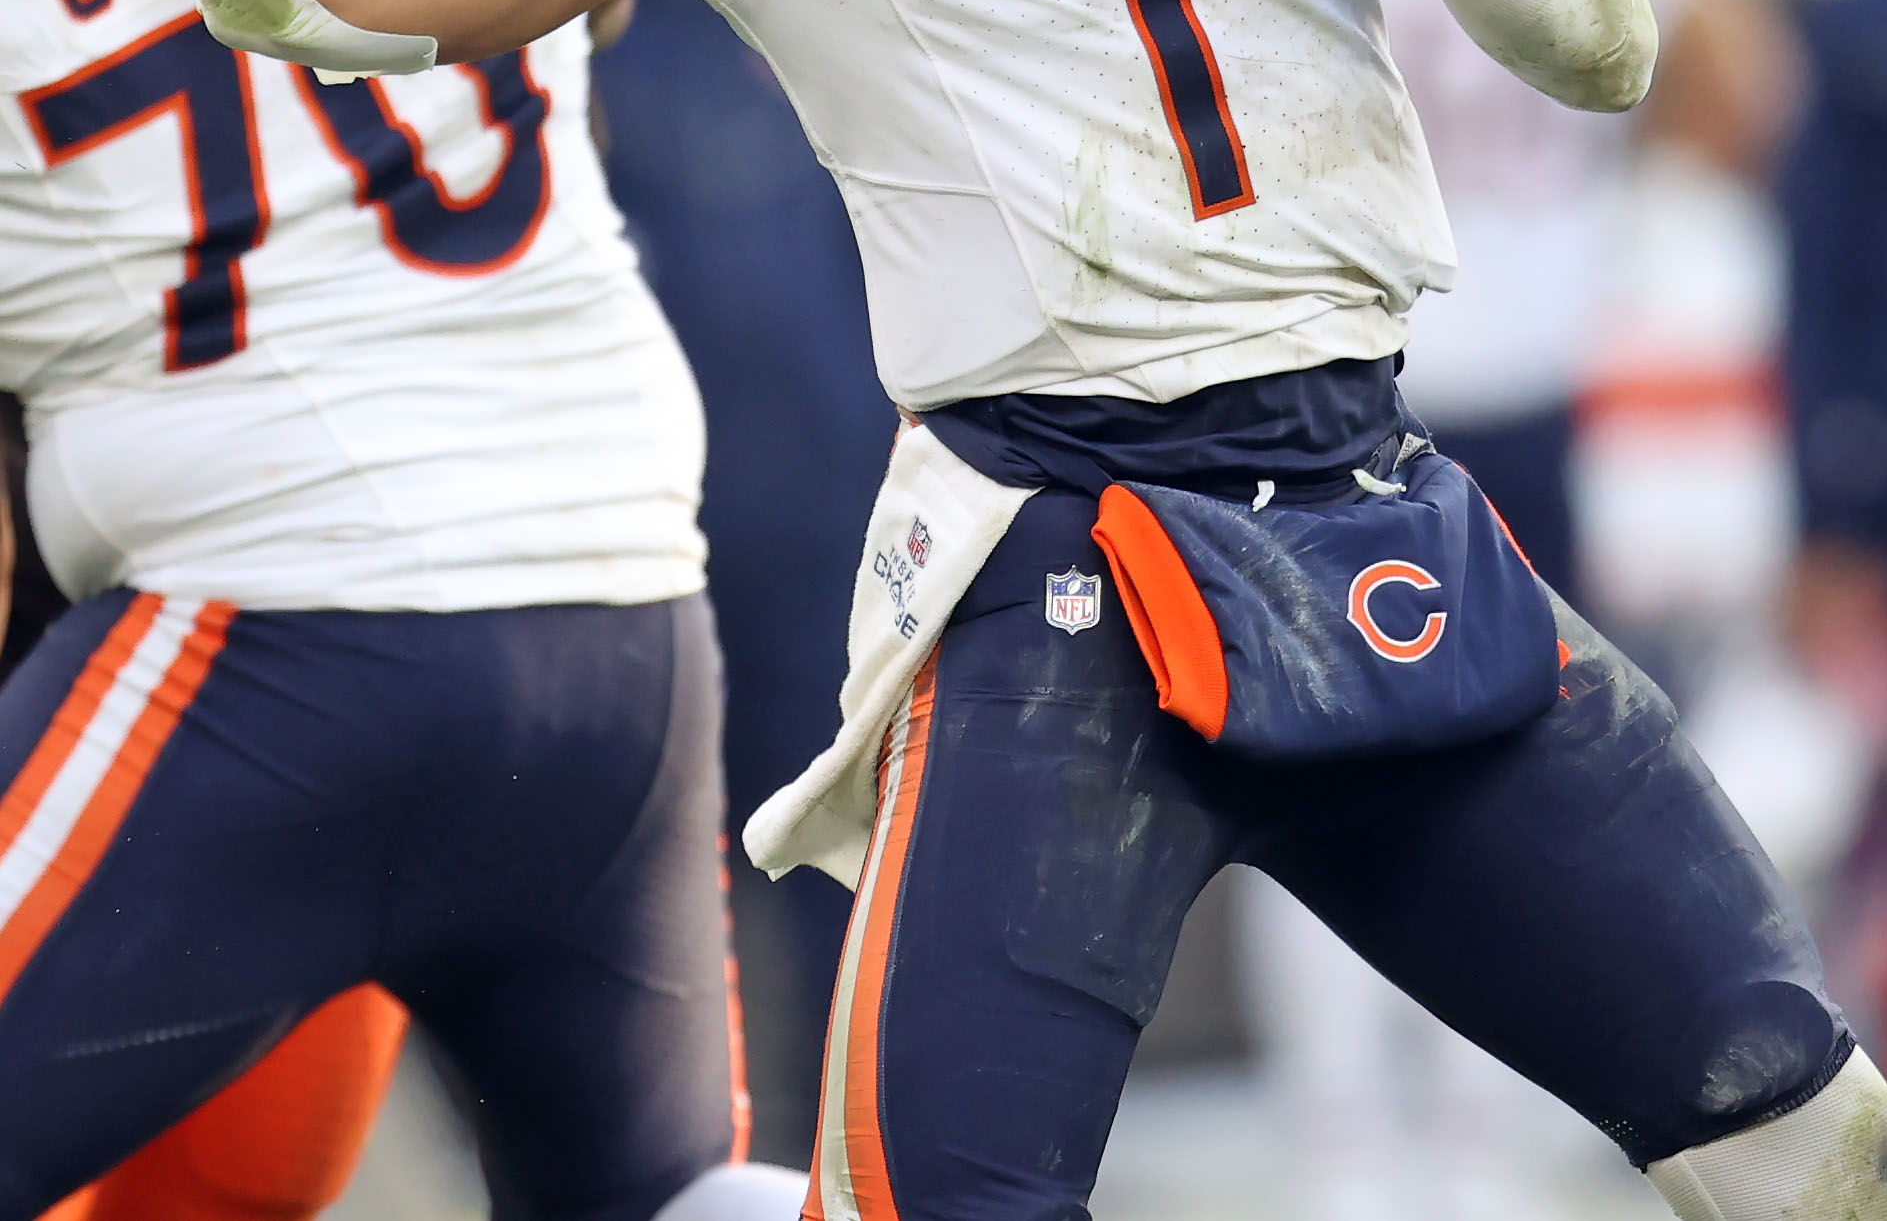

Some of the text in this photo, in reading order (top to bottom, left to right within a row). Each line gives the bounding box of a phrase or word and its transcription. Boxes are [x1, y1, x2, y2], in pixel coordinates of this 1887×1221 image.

[17, 7, 552, 374] 70
[1055, 598, 1092, 622] NFL
[1346, 559, 1448, 663] C
